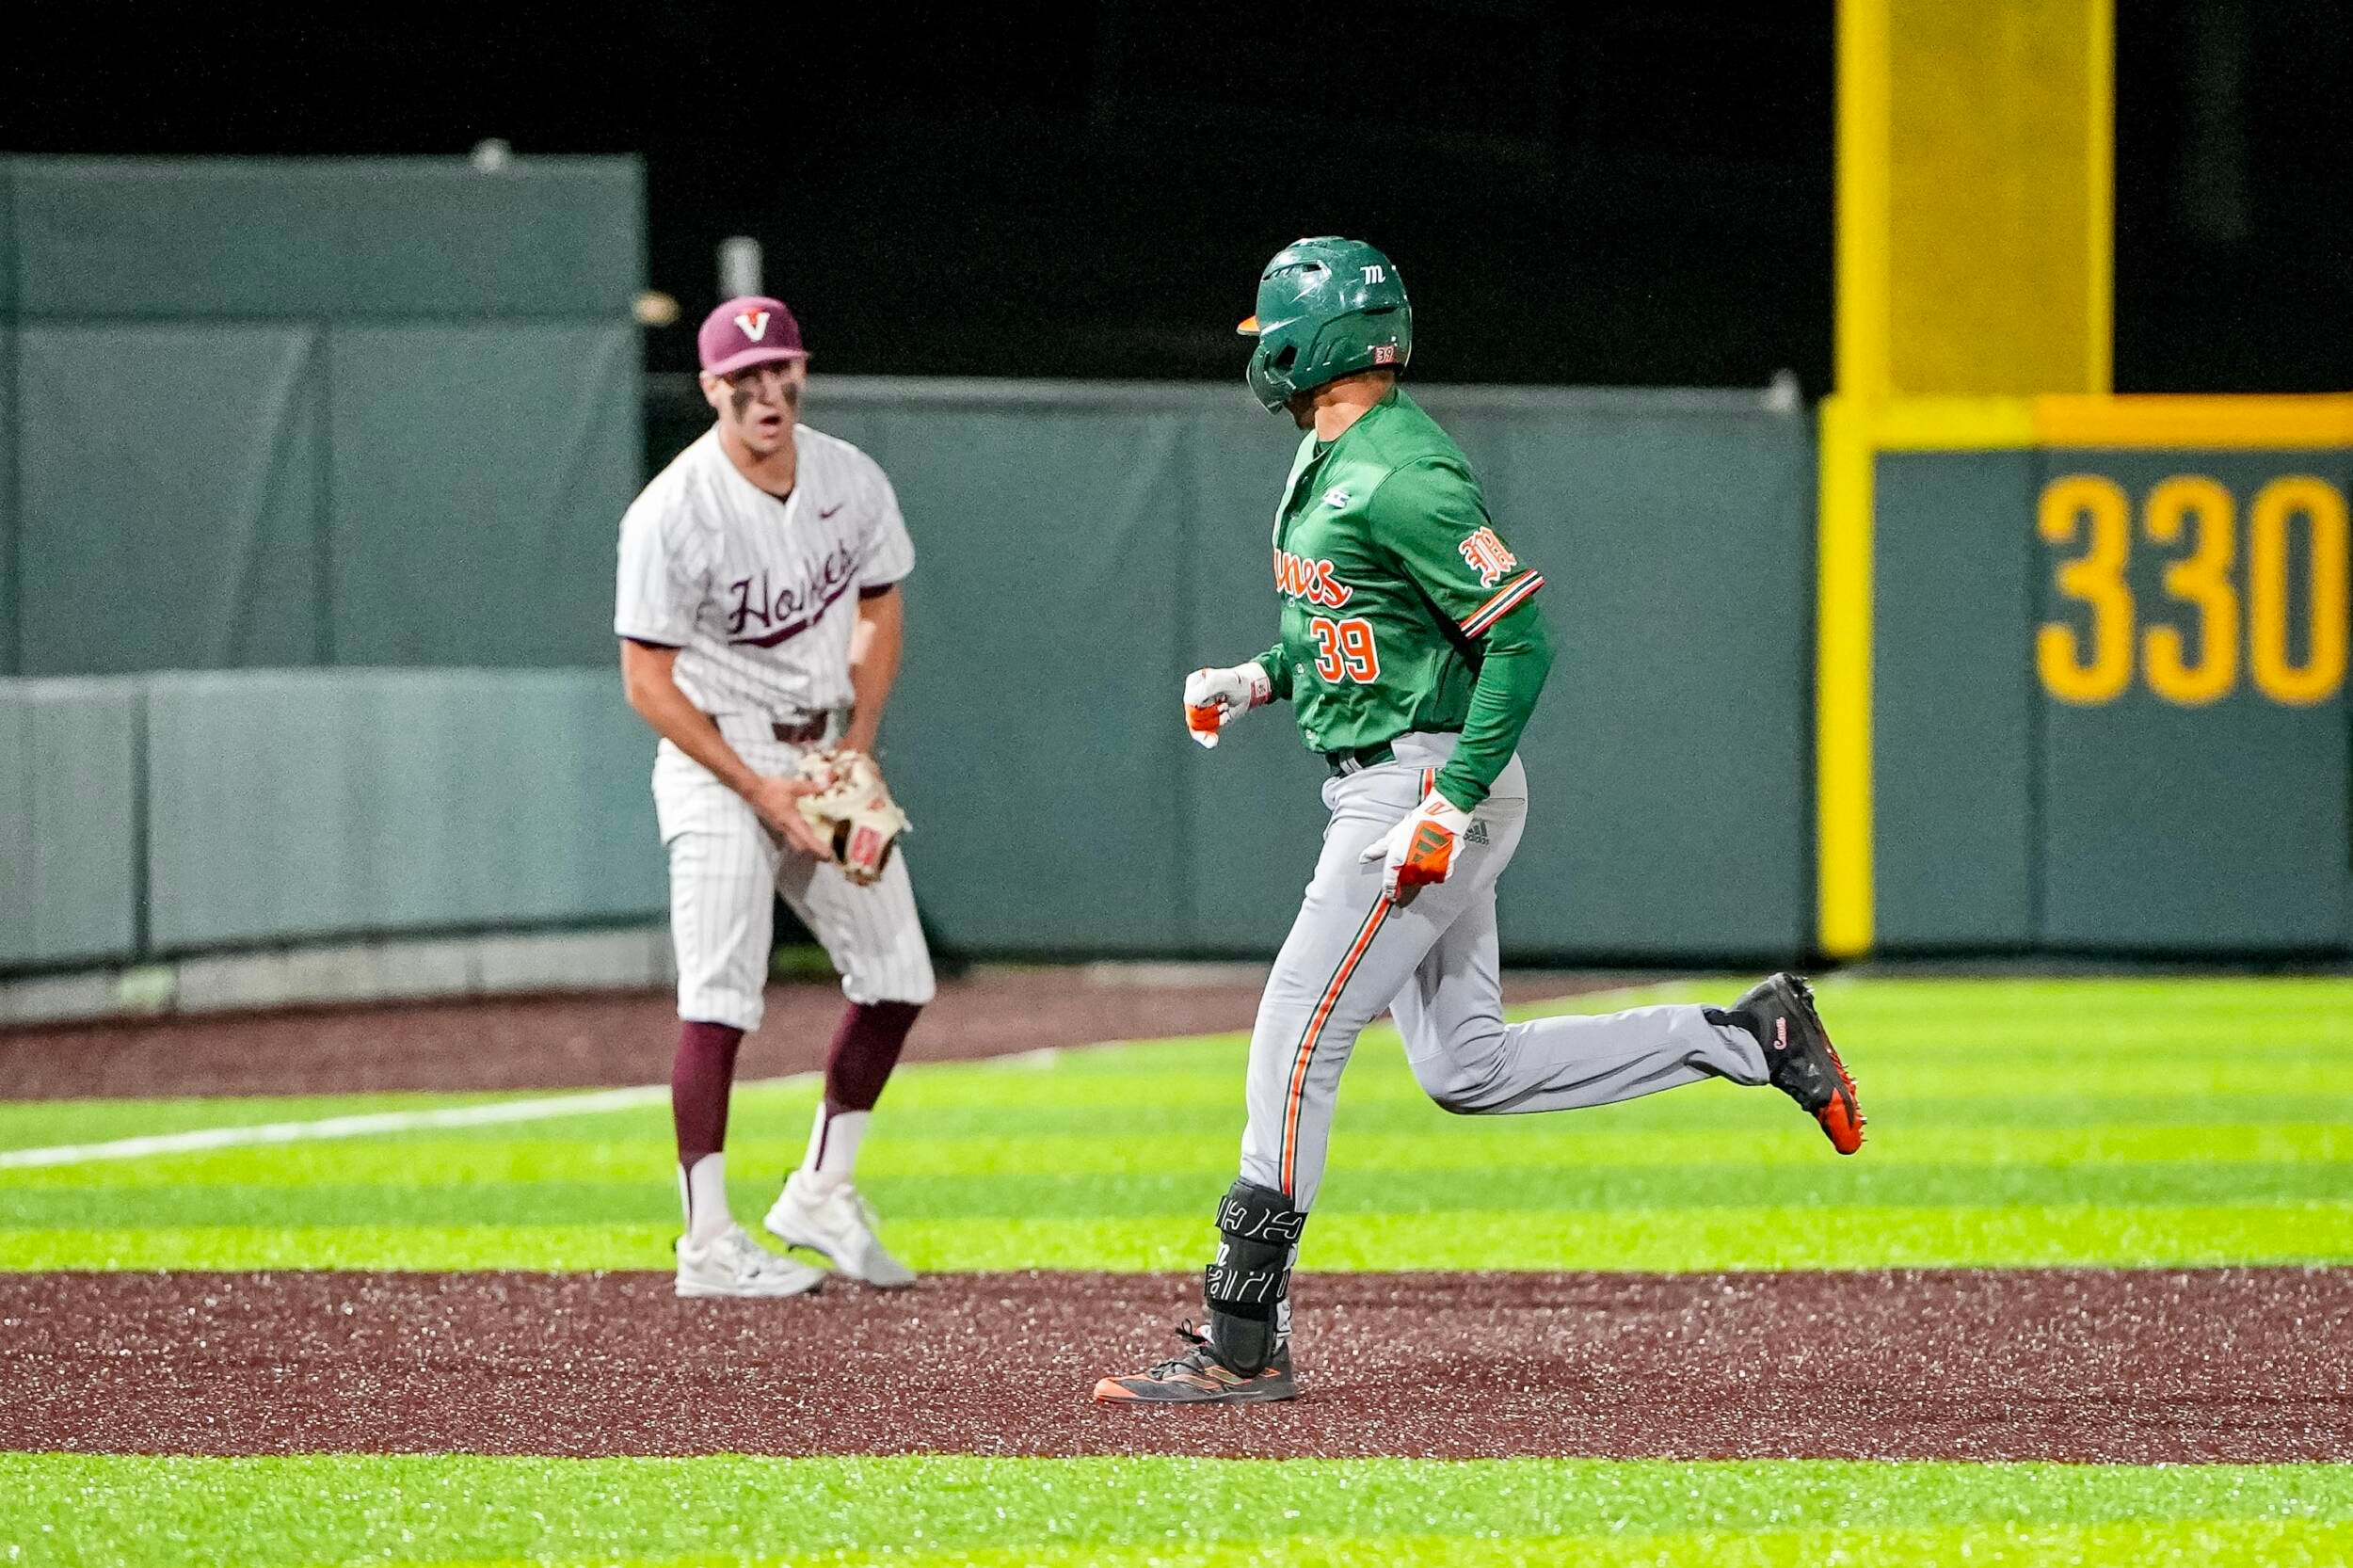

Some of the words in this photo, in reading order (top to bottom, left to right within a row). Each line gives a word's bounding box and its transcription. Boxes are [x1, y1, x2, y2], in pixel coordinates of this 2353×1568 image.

[1375, 346, 1395, 364] 39
[728, 538, 853, 635] Hokes
[1273, 549, 1353, 609] nes
[2037, 475, 2347, 705] 330
[1310, 616, 1380, 683] 39
